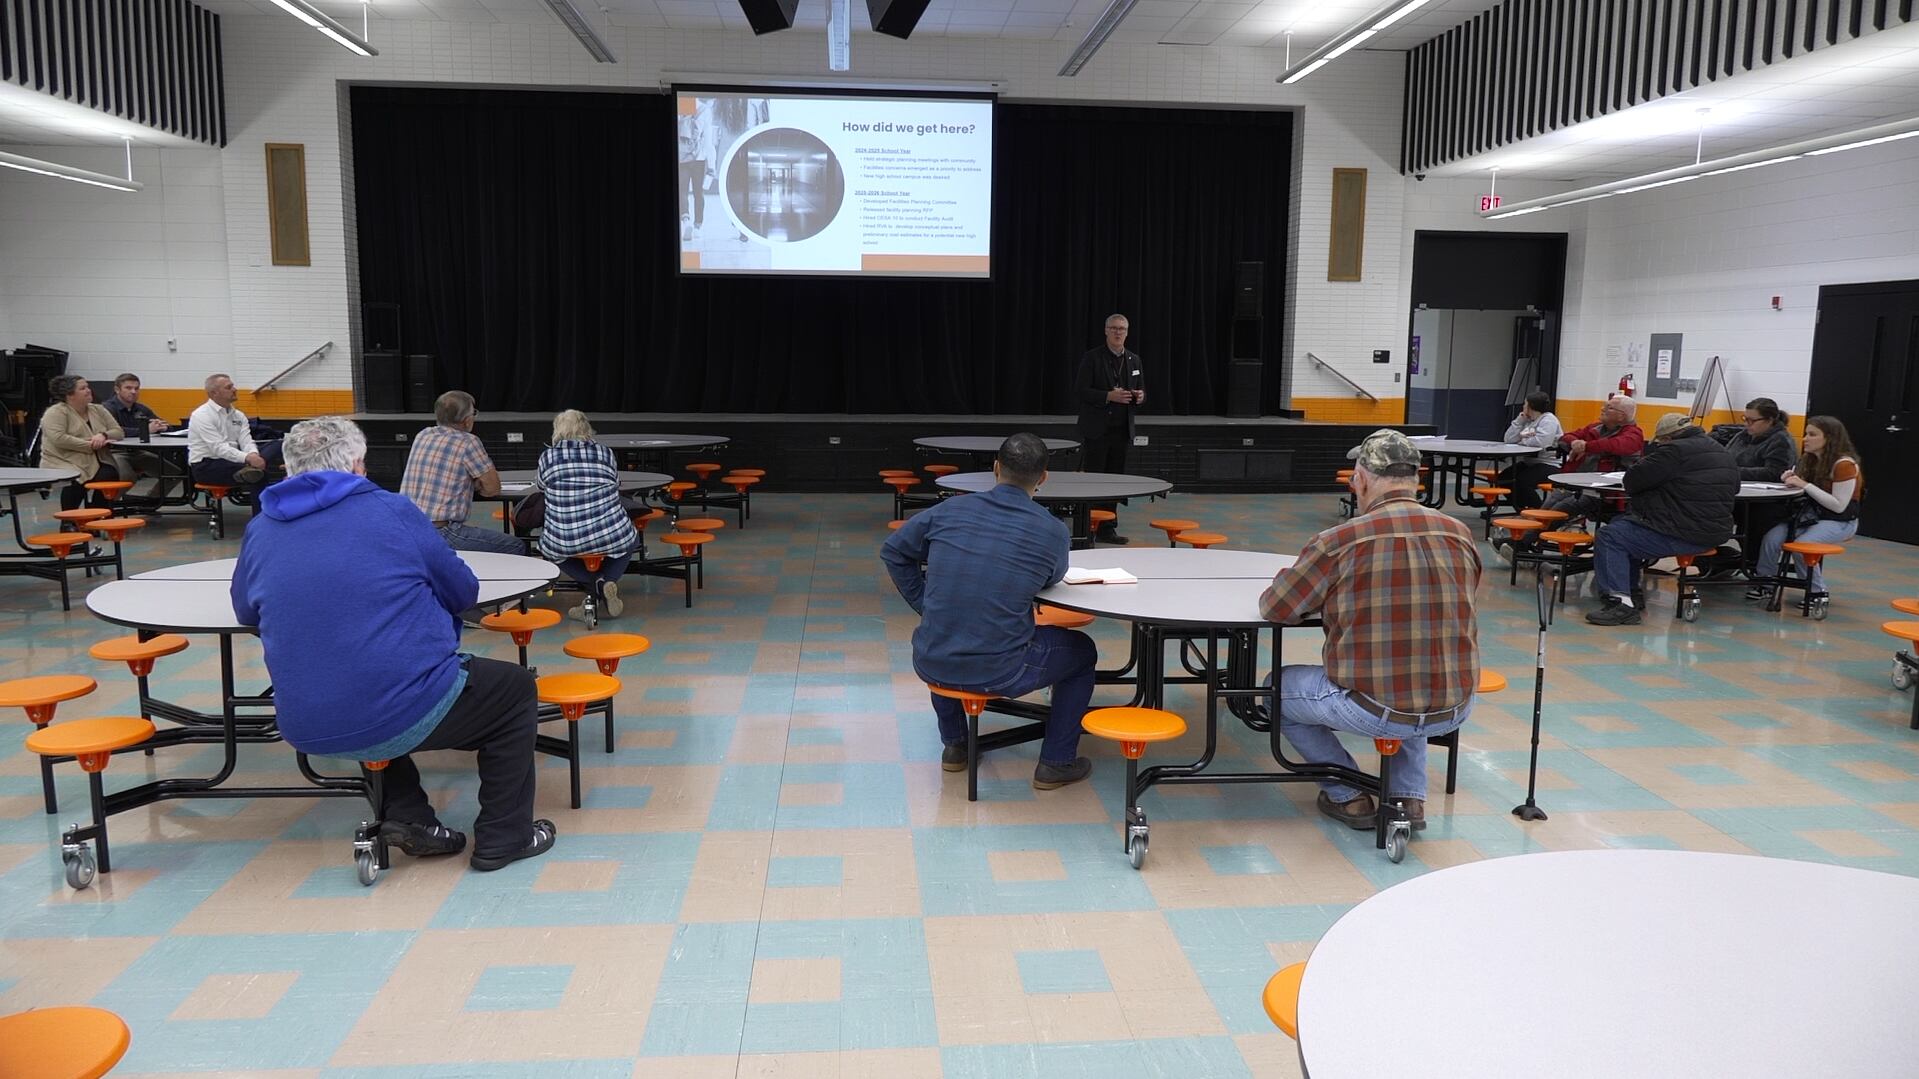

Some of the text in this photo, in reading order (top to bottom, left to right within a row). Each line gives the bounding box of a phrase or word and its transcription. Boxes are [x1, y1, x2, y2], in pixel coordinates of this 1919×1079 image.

[842, 121, 976, 136] How did we get here?
